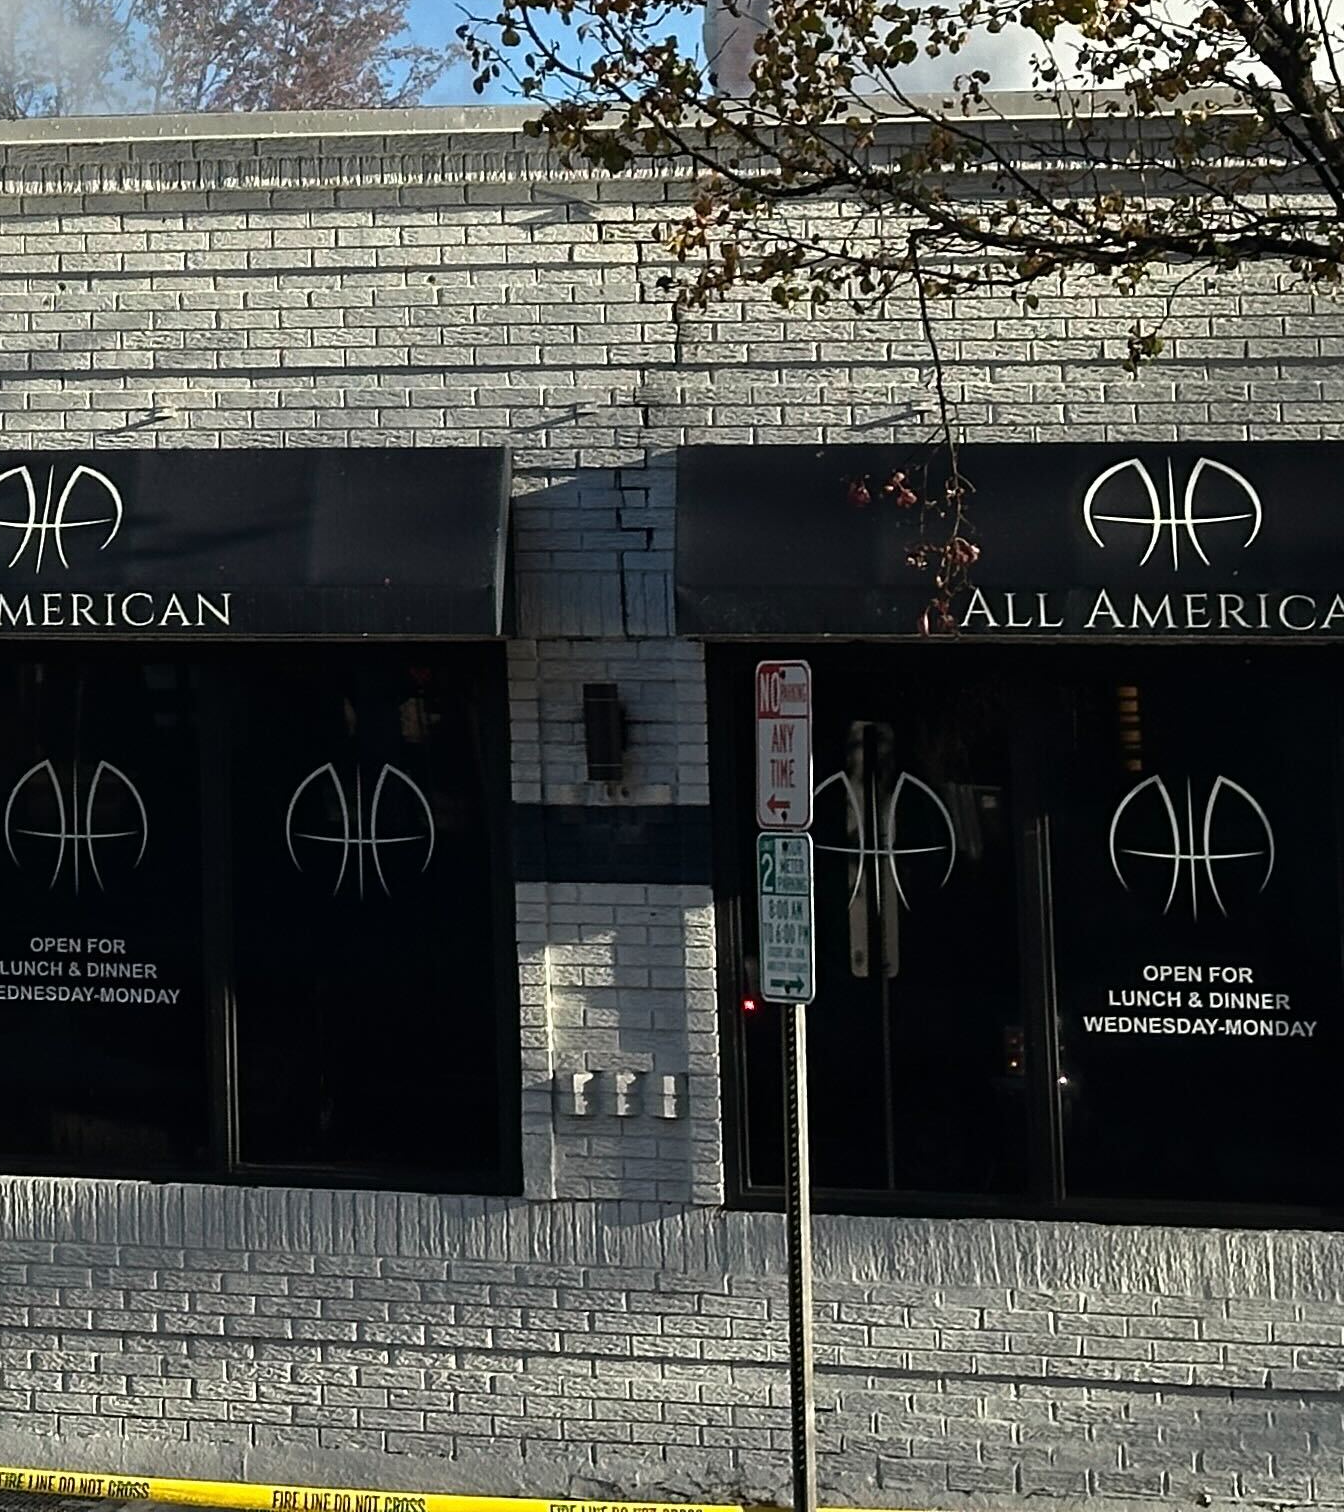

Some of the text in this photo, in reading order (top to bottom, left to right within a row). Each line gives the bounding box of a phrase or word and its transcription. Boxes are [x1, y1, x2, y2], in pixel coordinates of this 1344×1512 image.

[960, 588, 1064, 628] ALL
[760, 671, 780, 713] NO
[771, 723, 795, 754] ANY
[770, 758, 796, 789] TIME
[761, 852, 774, 893] 2
[29, 937, 127, 954] OPEN FOR
[0, 960, 158, 979] LUNCH & DINNER
[1142, 965, 1254, 984] OPEN FOR
[1108, 990, 1291, 1010] LUNCH & DINNER
[1083, 1015, 1318, 1038] WEDNESDAY-MONDAY
[29, 1473, 56, 1492] LINE
[59, 1476, 76, 1494] DO
[79, 1478, 105, 1496] NOT
[108, 1480, 151, 1499] CROSS
[272, 1490, 426, 1512] FIRE LINE DO NOT CROSS
